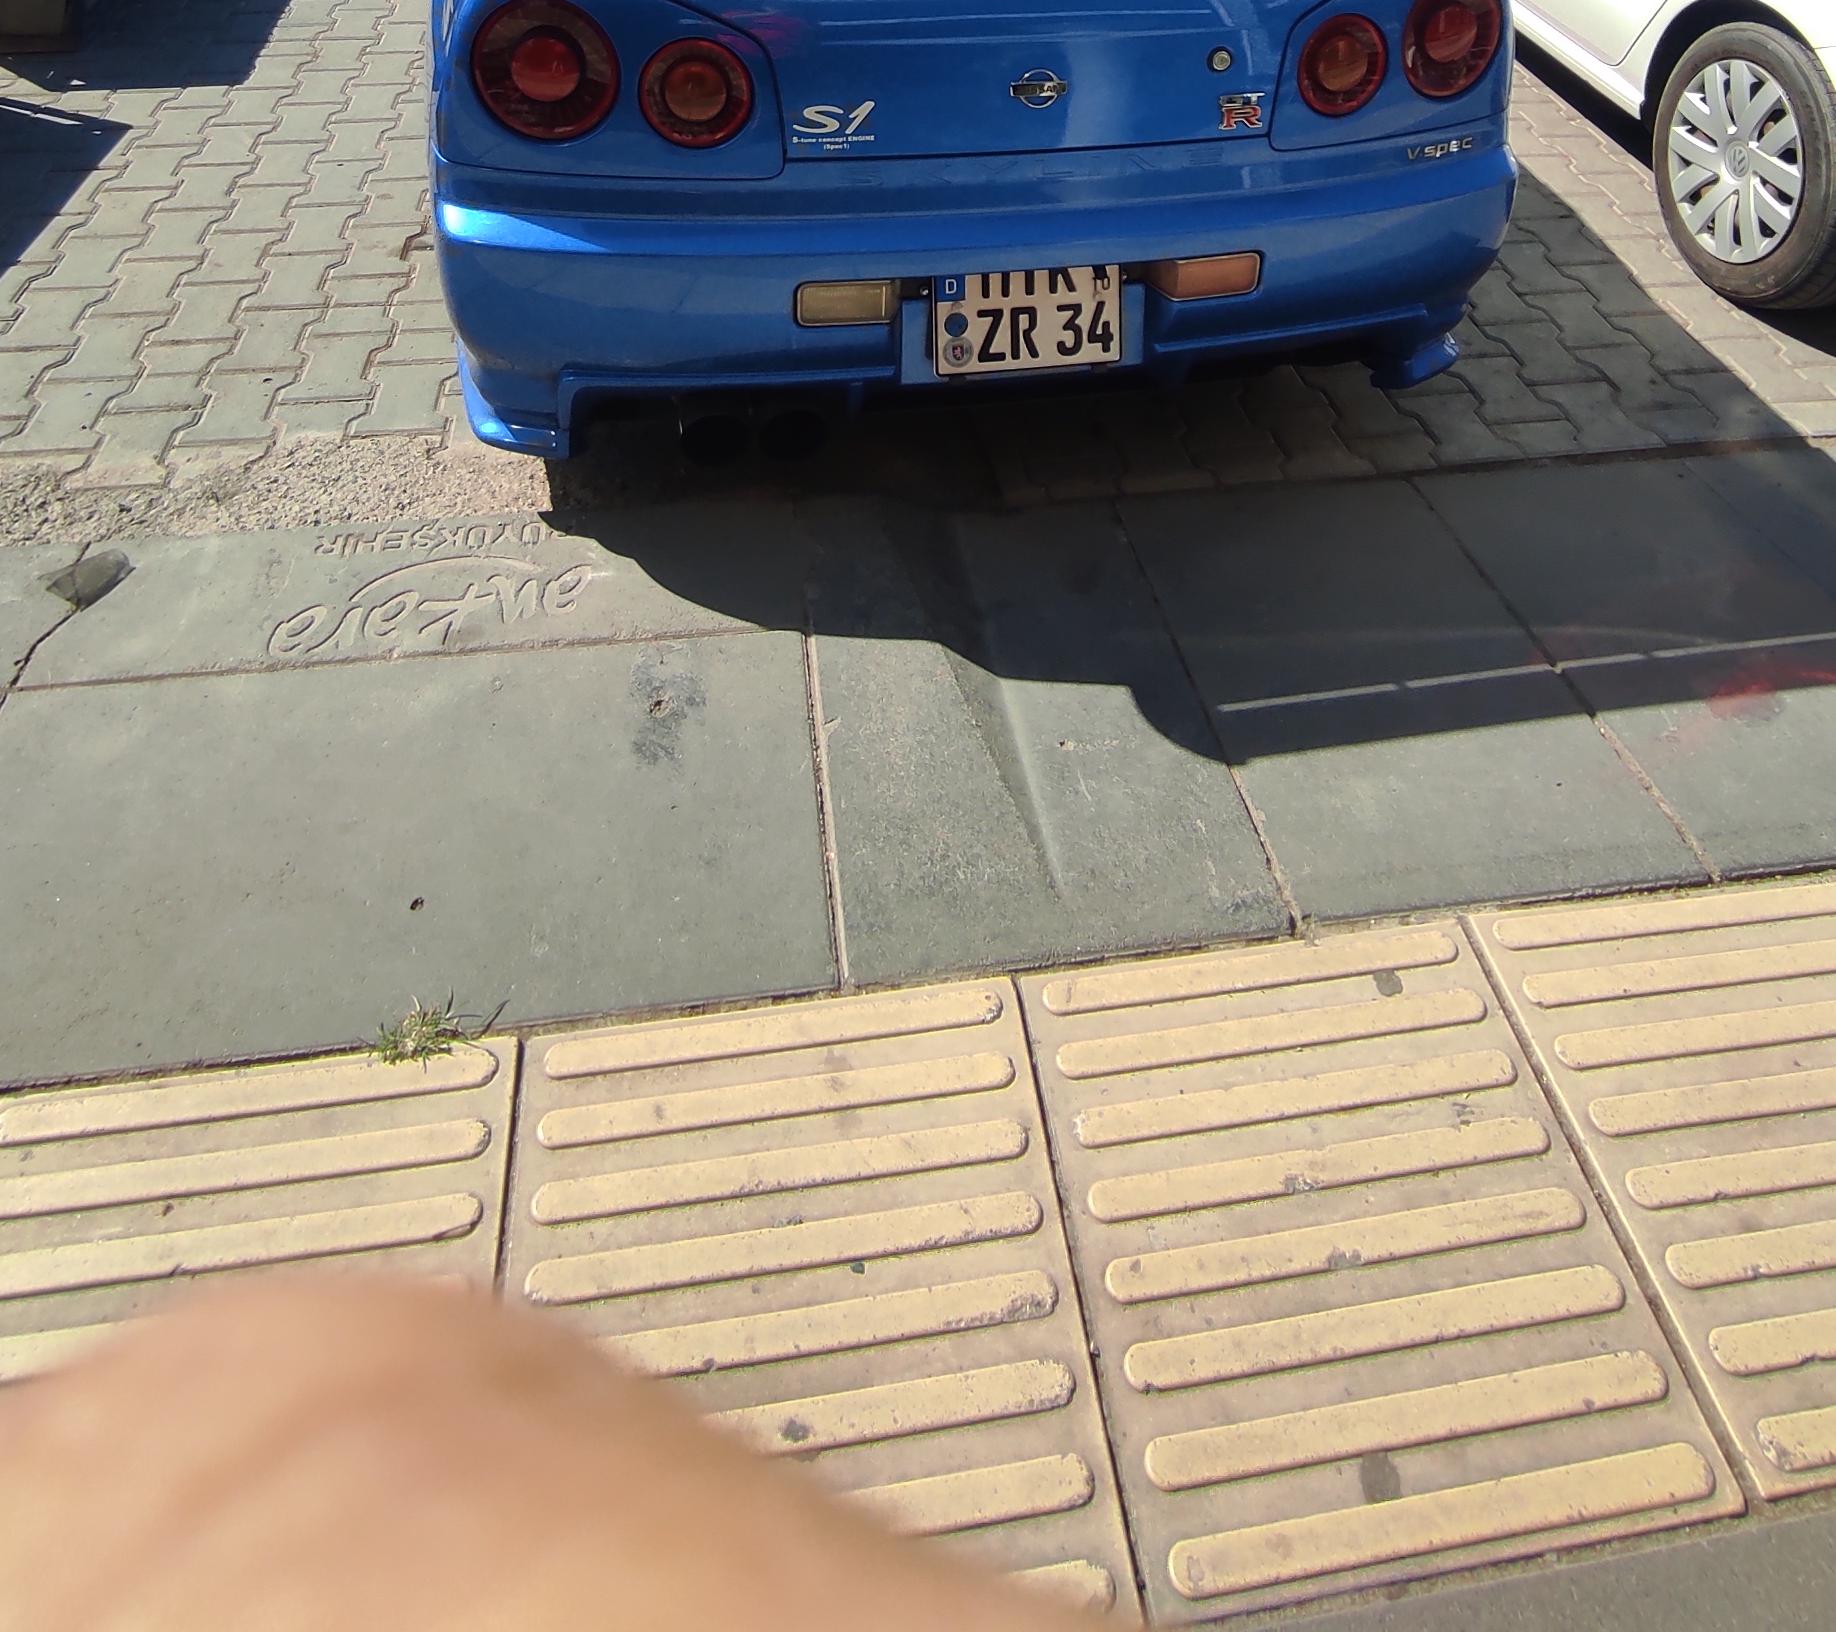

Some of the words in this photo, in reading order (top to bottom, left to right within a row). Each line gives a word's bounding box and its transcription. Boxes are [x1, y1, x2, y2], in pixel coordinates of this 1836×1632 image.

[792, 100, 876, 135] S1
[1219, 105, 1263, 130] R
[945, 279, 957, 294] D
[977, 306, 1040, 363] ZR
[1056, 300, 1114, 357] 34
[314, 518, 570, 559] ÜYÜKŞEHİR
